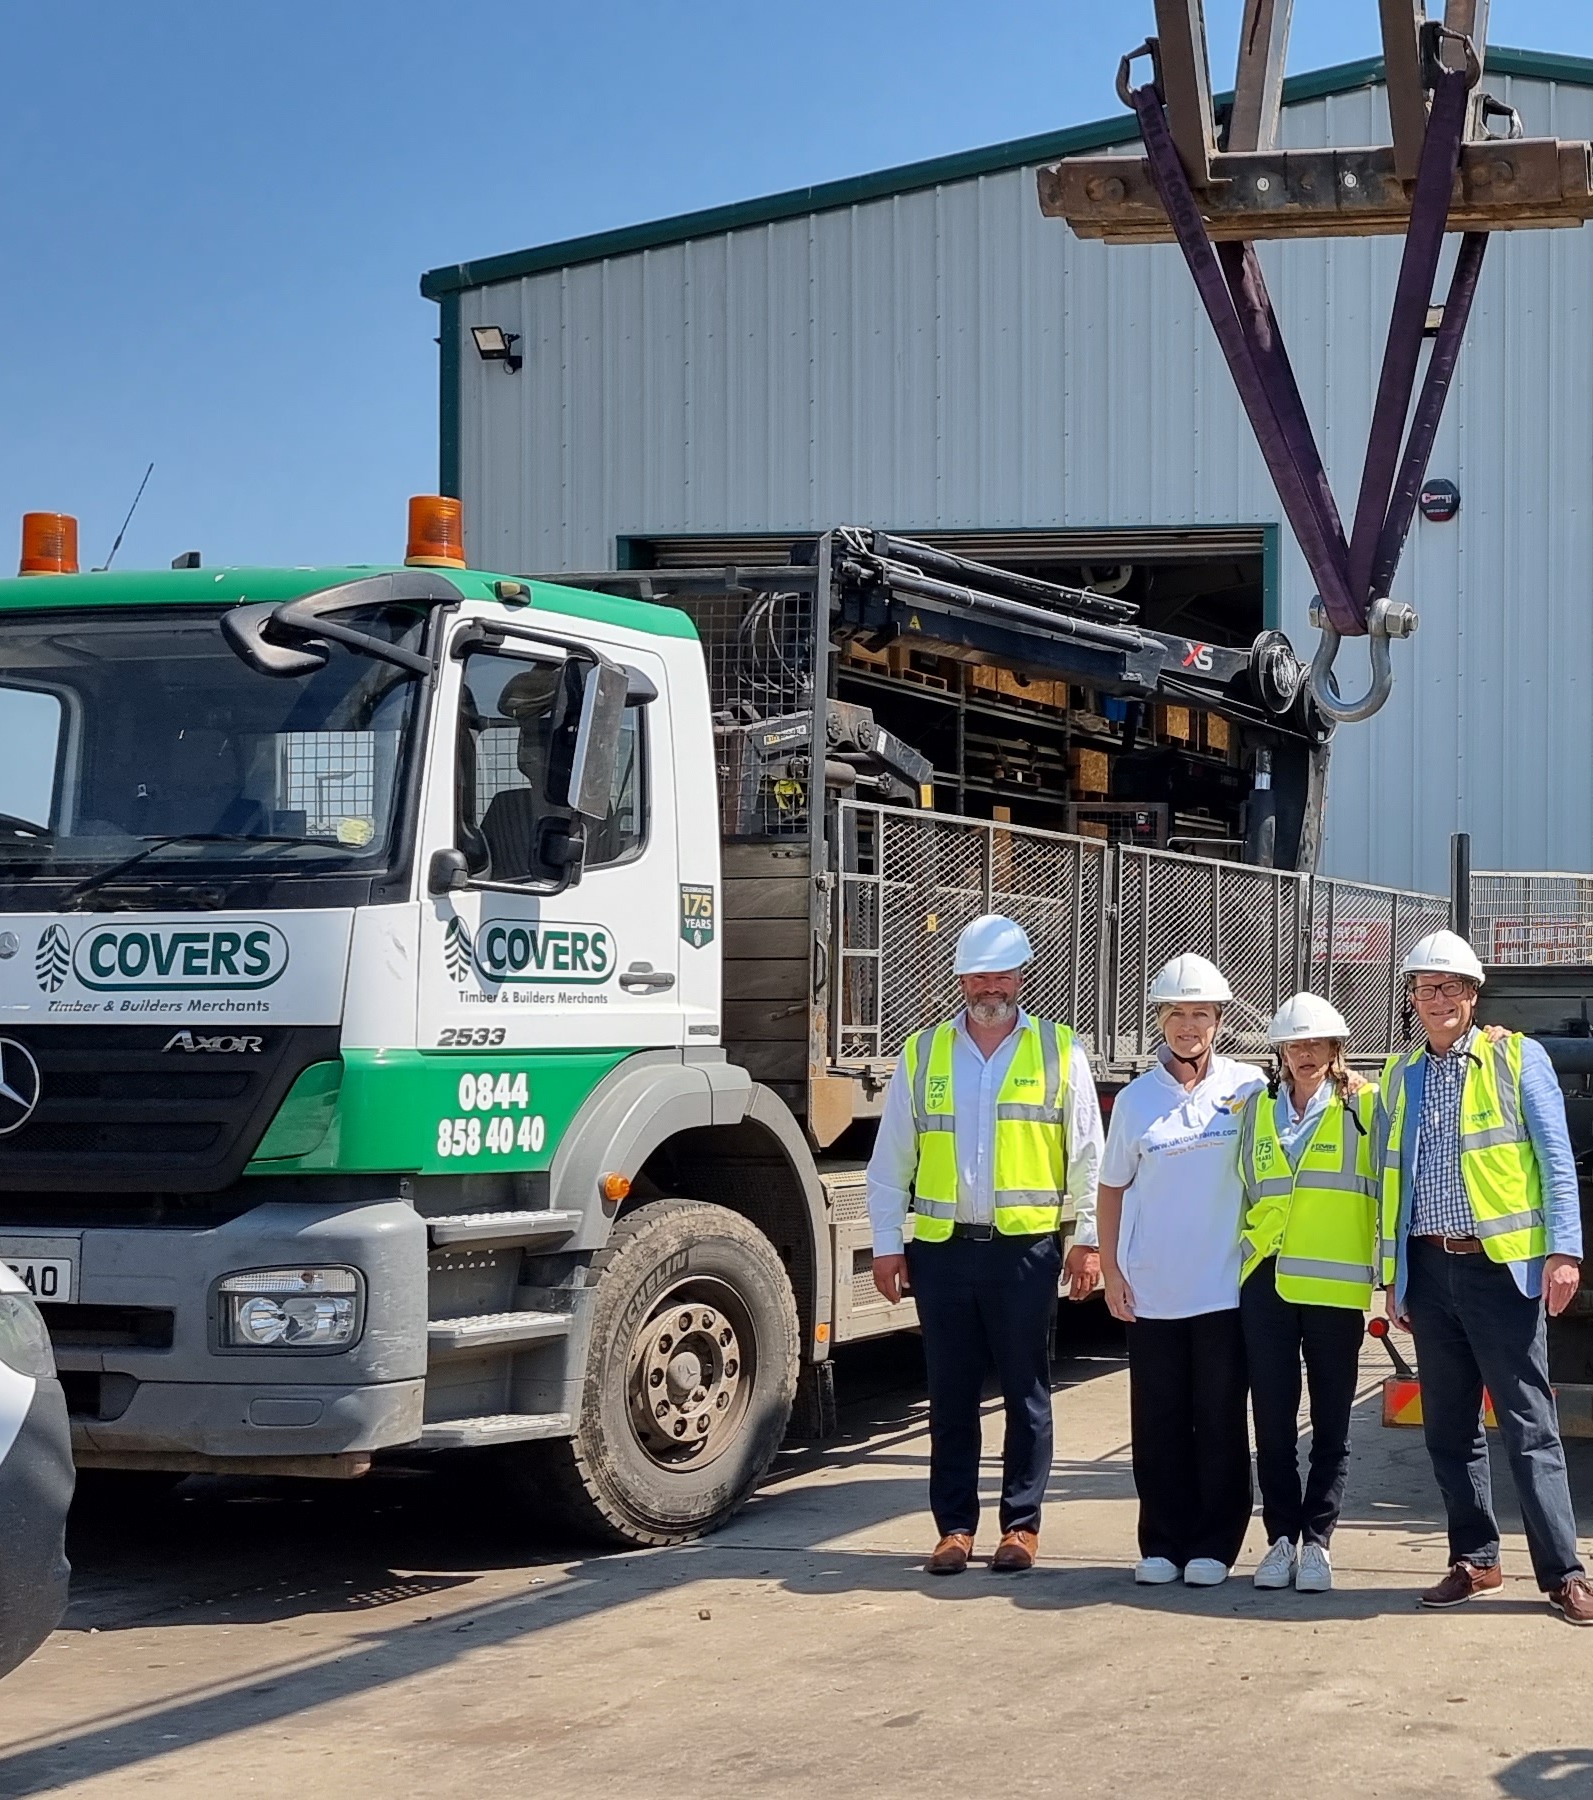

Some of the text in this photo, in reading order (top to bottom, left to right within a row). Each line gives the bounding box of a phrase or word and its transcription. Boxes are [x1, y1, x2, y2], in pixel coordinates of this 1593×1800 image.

[1182, 642, 1213, 670] XS
[682, 894, 712, 917] 175
[684, 918, 712, 929] YEARS
[89, 931, 271, 977] COVERS
[487, 927, 607, 973] COVERS
[48, 999, 270, 1012] Timber & Builders Merchants
[458, 991, 608, 1004] Timber & Builders Merchants
[437, 1028, 506, 1047] 2533
[458, 1073, 529, 1111] 0844
[437, 1115, 545, 1157] 858 40 40
[1147, 1129, 1238, 1153] www.uktoukraine.com
[613, 1250, 688, 1358] MICHELIN
